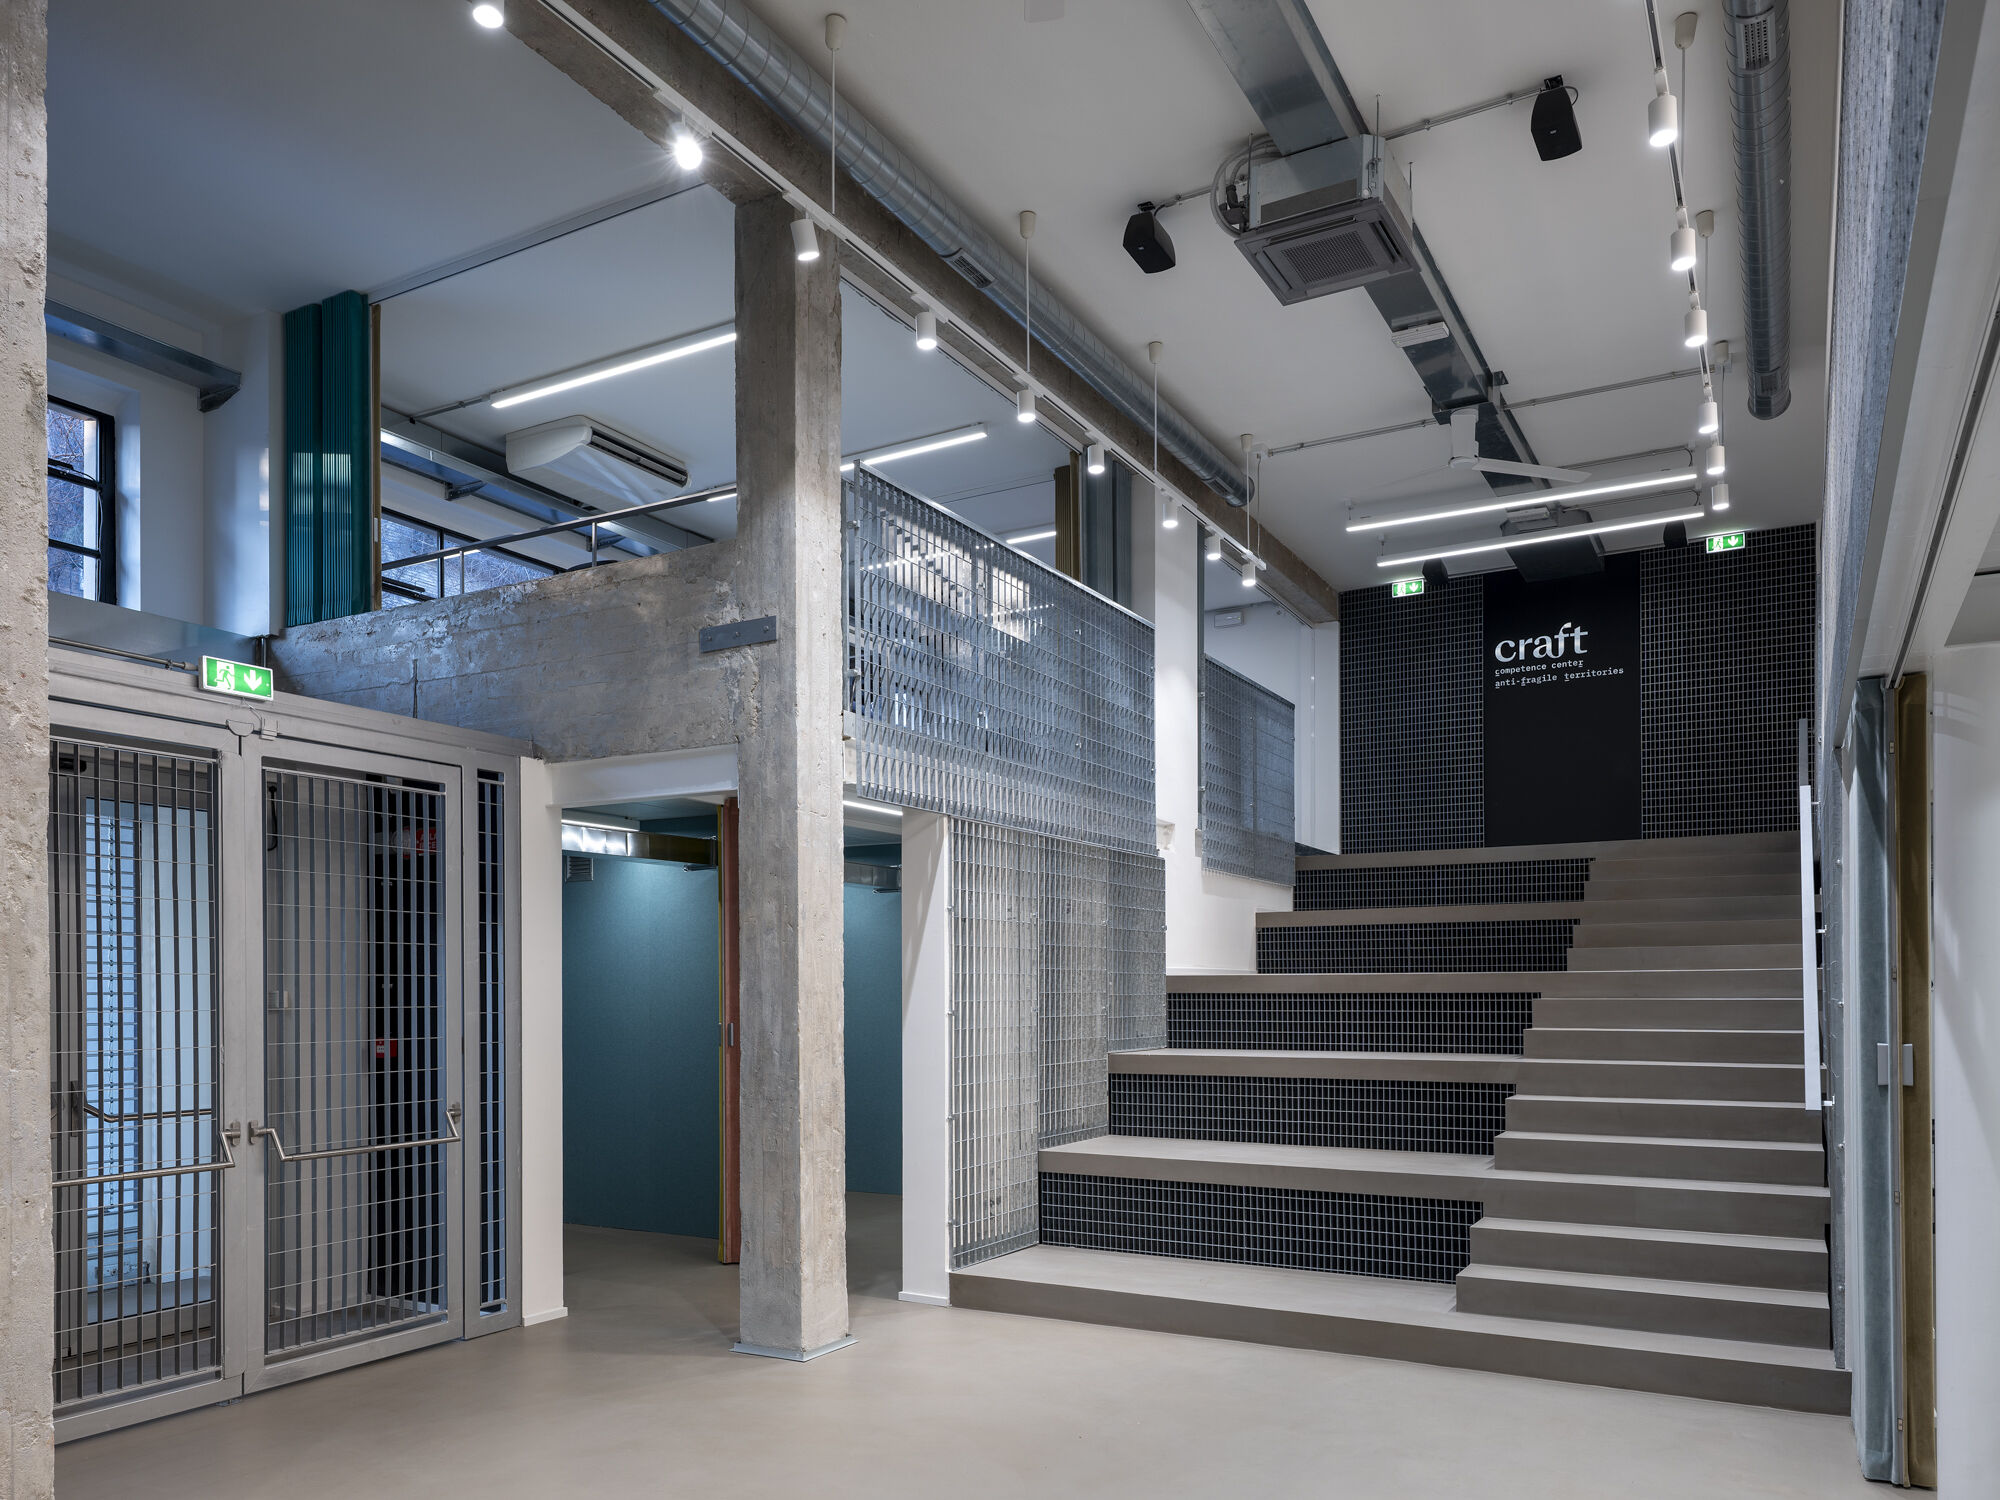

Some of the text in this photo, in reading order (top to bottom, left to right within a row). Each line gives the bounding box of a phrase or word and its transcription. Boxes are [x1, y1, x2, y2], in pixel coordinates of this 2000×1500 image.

[1494, 621, 1589, 663] craft
[1494, 659, 1584, 677] competence center
[1494, 666, 1624, 689] anti-fragile territories
